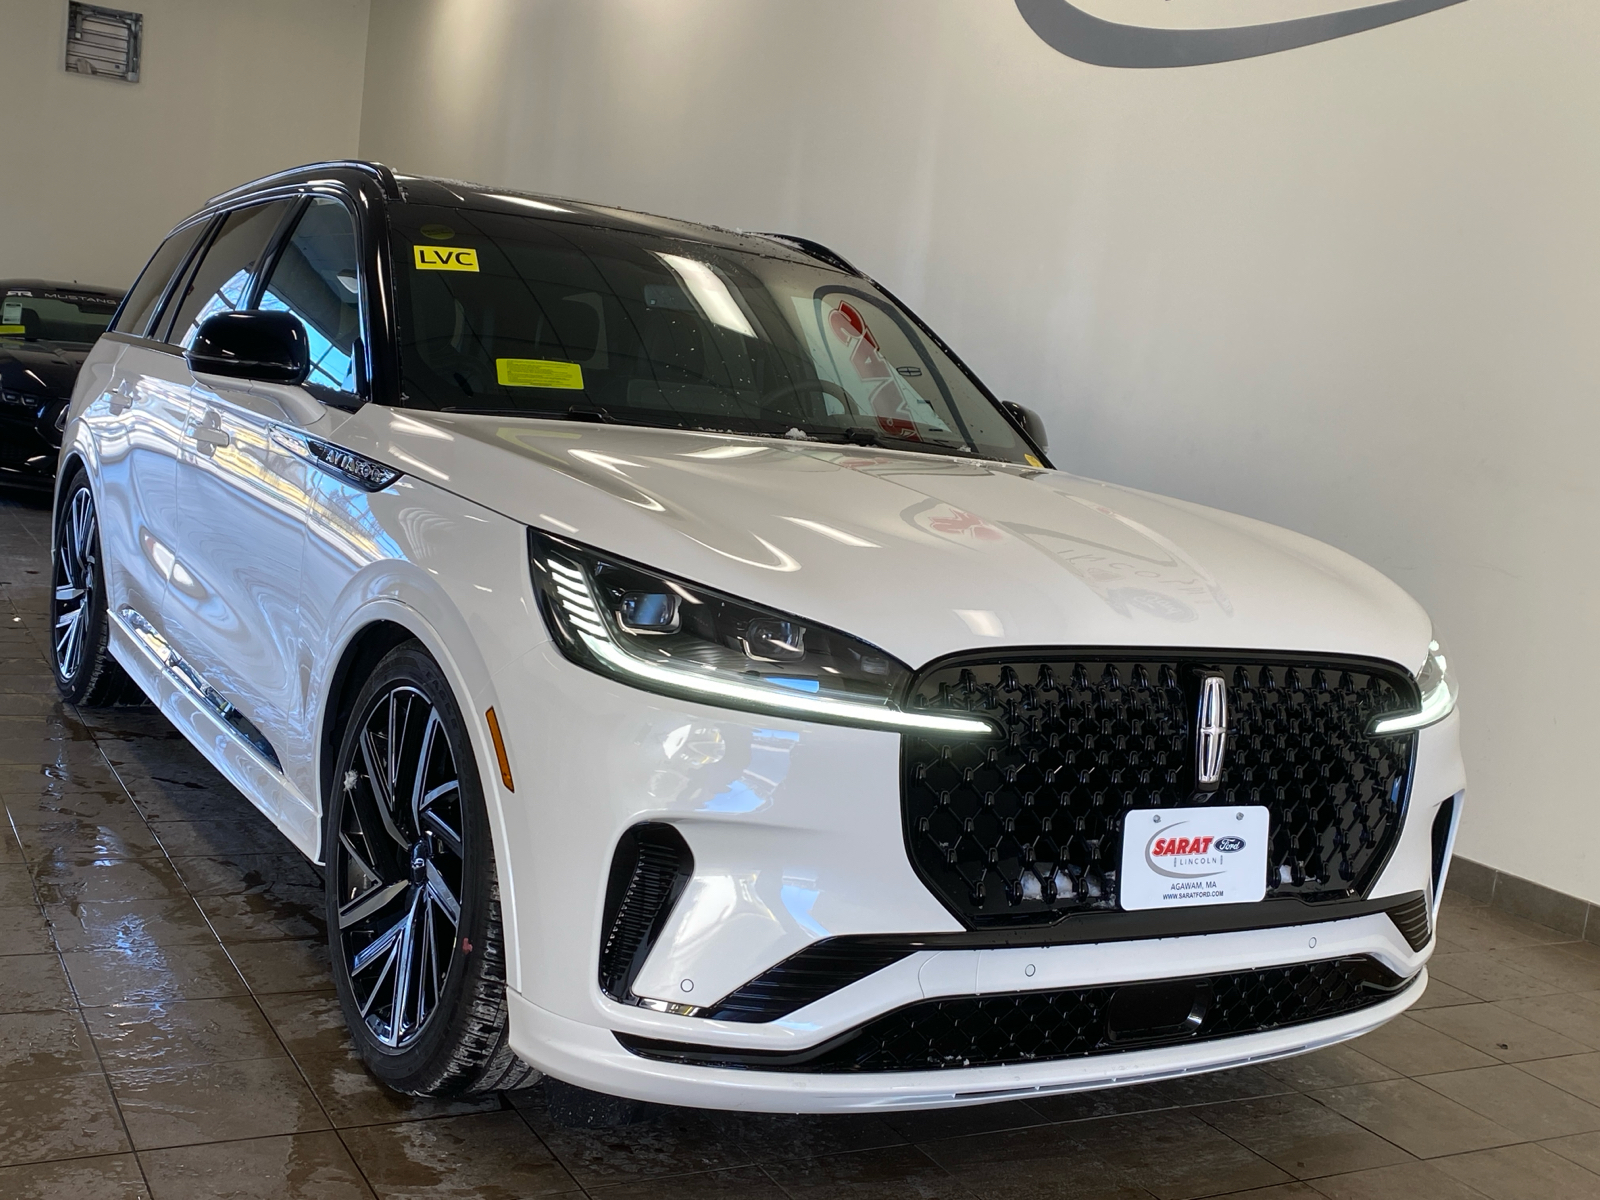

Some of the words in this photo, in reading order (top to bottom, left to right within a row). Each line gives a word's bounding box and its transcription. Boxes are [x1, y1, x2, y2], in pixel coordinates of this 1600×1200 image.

[419, 249, 474, 266] LVC
[44, 292, 117, 305] MUSTANG
[1152, 836, 1214, 857] SARAT
[1179, 857, 1217, 866] LINCOLN
[1170, 882, 1204, 891] AGAWAM,
[1205, 881, 1217, 889] MA
[1162, 890, 1224, 900] WWW.SARATFORD.COM
